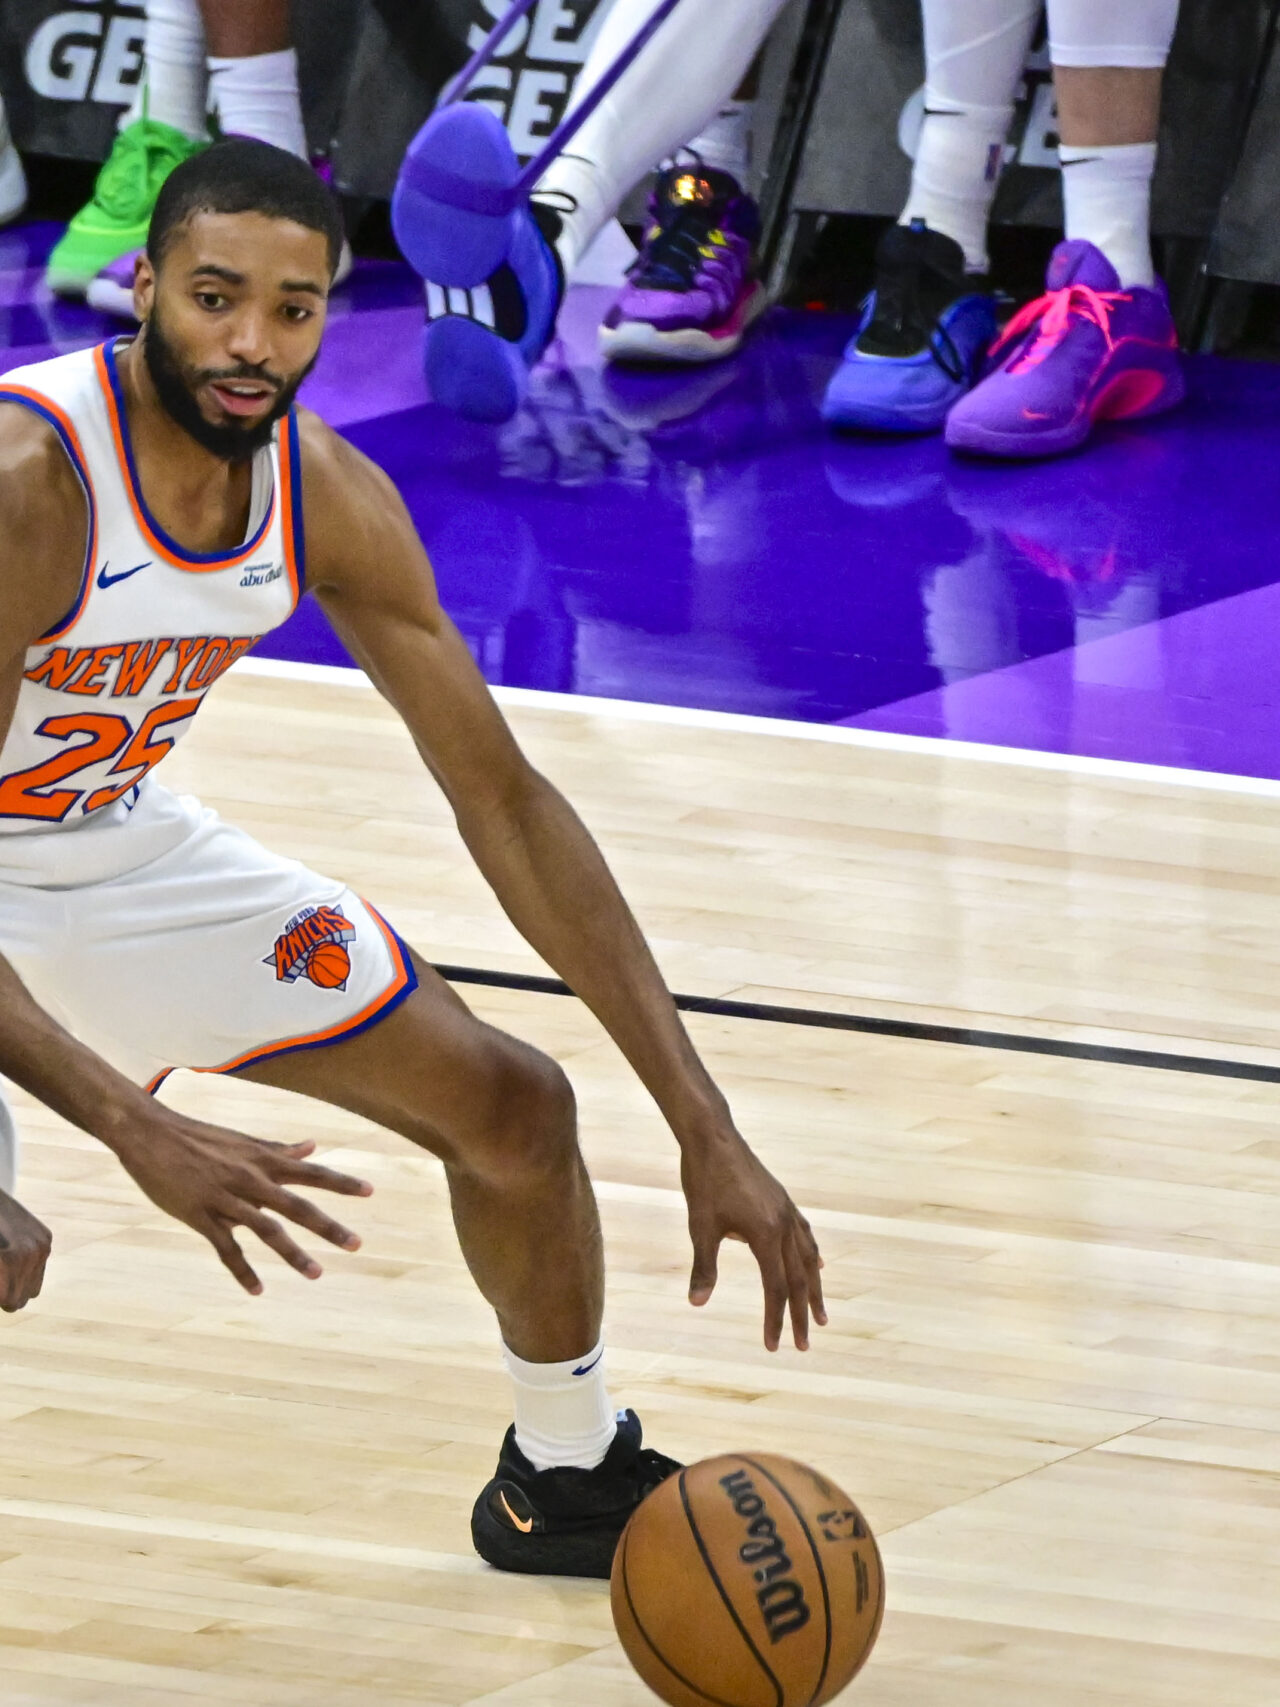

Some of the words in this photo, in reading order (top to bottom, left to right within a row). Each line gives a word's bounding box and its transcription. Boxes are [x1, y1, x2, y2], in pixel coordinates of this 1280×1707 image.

[23, 637, 176, 697] NEW
[161, 634, 263, 694] YOR
[274, 906, 355, 984] KNICKS
[719, 1469, 810, 1645] Wilson
